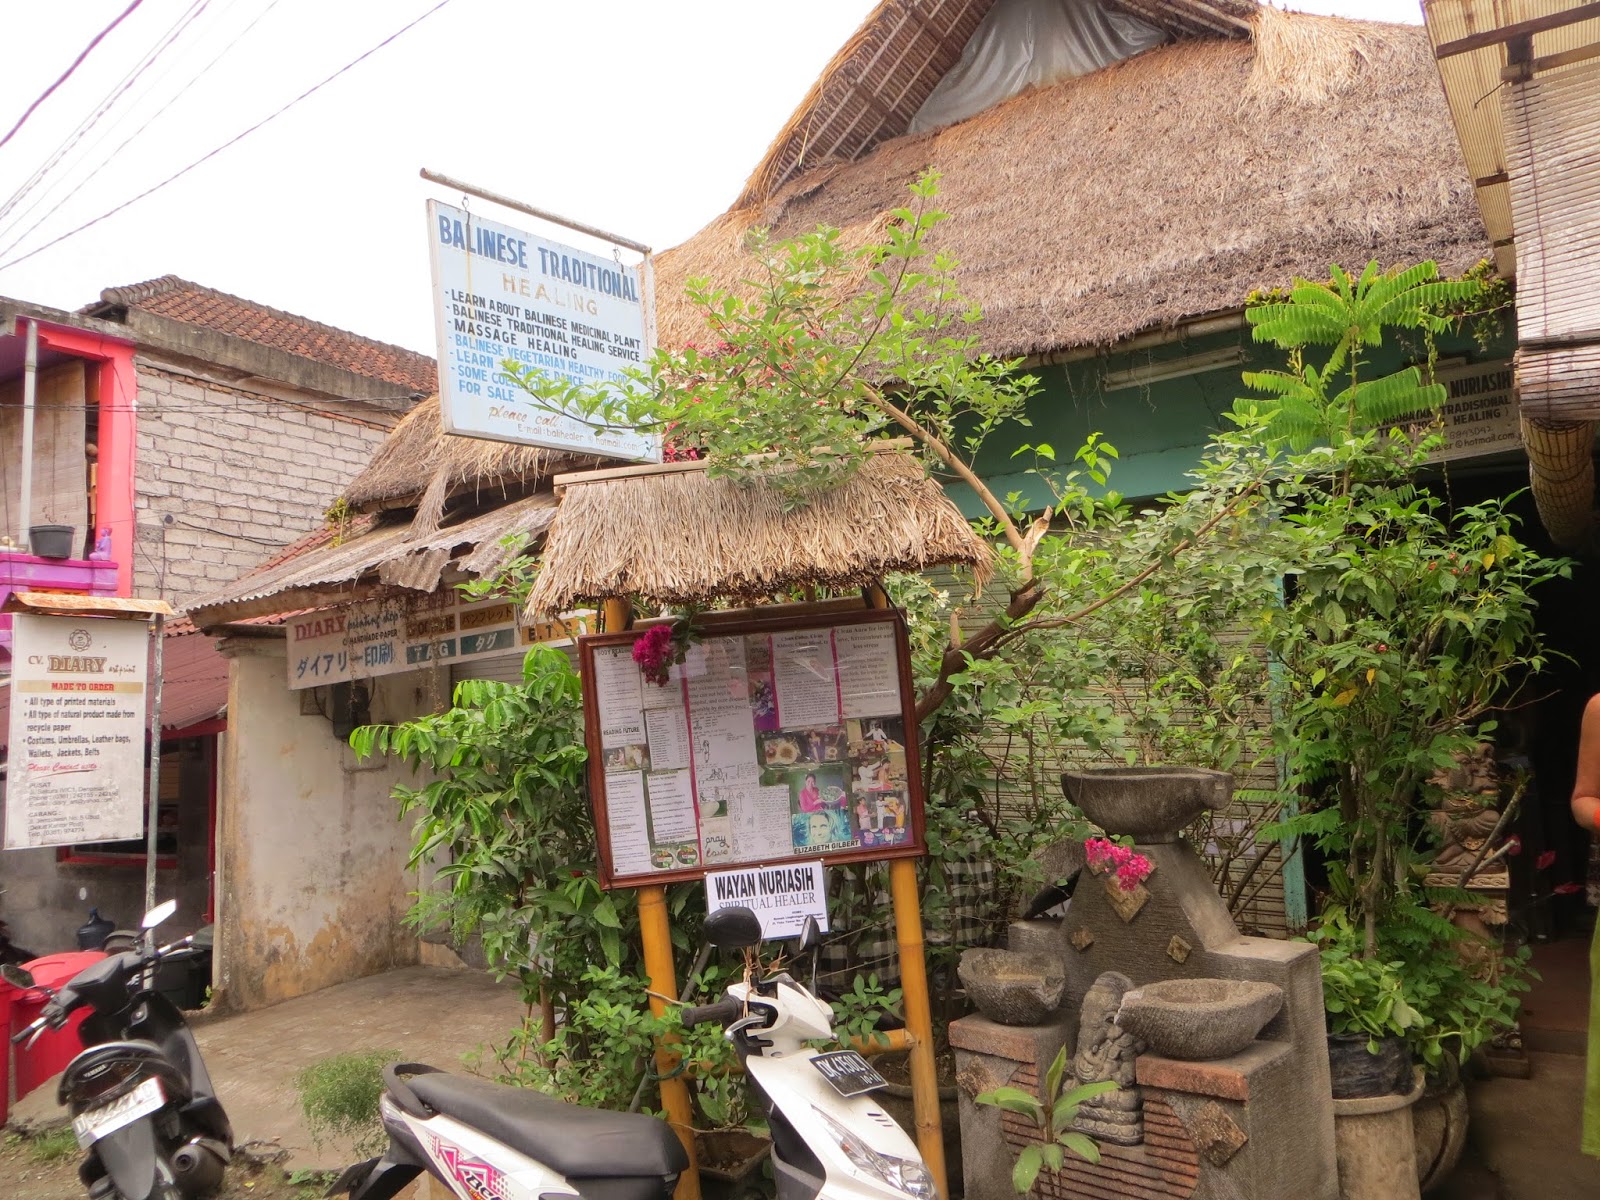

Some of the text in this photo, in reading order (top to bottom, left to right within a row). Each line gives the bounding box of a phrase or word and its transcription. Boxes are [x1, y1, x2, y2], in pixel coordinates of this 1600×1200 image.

[438, 215, 639, 304] BALINESE TRADITIONAL
[503, 273, 598, 315] HEALING
[451, 289, 640, 350] LEARN ABOUT BALINESE MEDICINAL PLANT
[452, 304, 640, 362] BALINESE TRADITIONAL HEALING SERVICE
[454, 318, 577, 360] MASSAGE HEALING
[455, 334, 628, 384] BALINESE VEGETARIAN HEALTHY FOOD
[456, 349, 494, 369] LEARN
[458, 365, 488, 382] SOME
[459, 380, 515, 402] FOR SALE
[1450, 370, 1512, 398] NURIASIH
[488, 405, 528, 421] please
[1440, 395, 1511, 416] TRADISIONAL
[1453, 408, 1500, 426] HEALING
[294, 616, 347, 642] DIARY
[383, 610, 399, 626] shop
[475, 633, 499, 651] タグ
[414, 643, 449, 660] TAG
[28, 656, 44, 665] CV.
[47, 655, 107, 673] DIARY
[51, 682, 115, 692] MADE TO ORDER
[29, 697, 116, 707] All type of printed materials
[28, 710, 135, 720] All type of natural product made from
[27, 723, 72, 733] recycle paper
[92, 735, 114, 744] Leather
[85, 748, 100, 757] Belts
[705, 835, 730, 849] pray
[794, 840, 859, 854] ELIZABETH GILBERT
[715, 867, 814, 900] WAYAN NURIASIH
[719, 892, 816, 912] SPIRITUAL HEALER
[83, 1063, 107, 1078] YAMAHA
[816, 1058, 841, 1078] DK
